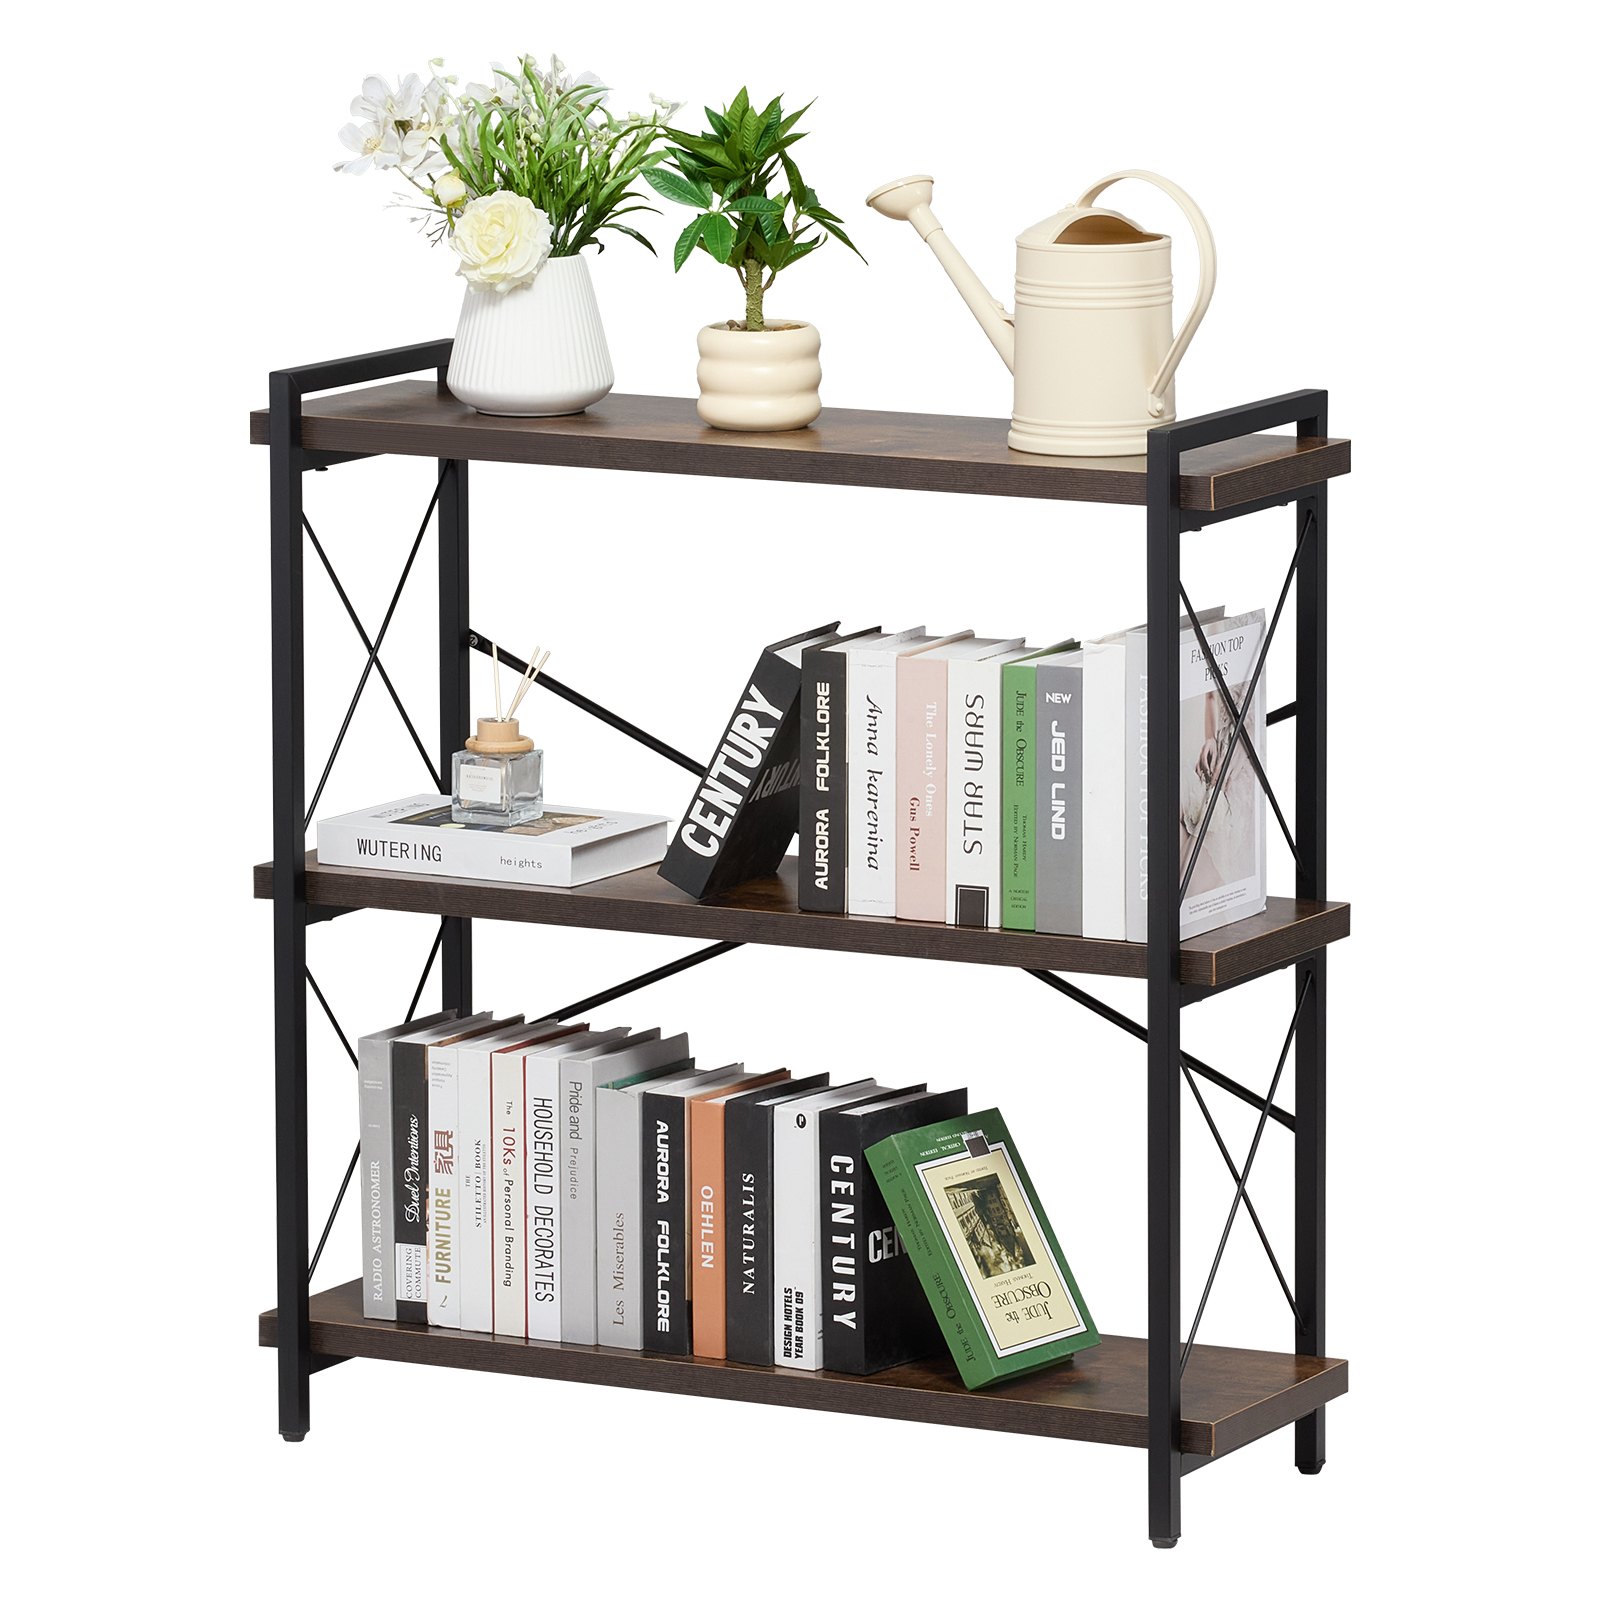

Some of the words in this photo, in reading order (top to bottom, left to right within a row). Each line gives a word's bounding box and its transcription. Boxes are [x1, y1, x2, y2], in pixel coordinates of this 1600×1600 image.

[1228, 635, 1244, 652] TOP
[925, 702, 937, 728] The
[1015, 690, 1027, 717] JUDE
[1046, 692, 1072, 704] NEW
[816, 682, 830, 791] FOLKLORE
[866, 694, 883, 756] Anna
[964, 694, 984, 772] WARS
[1016, 719, 1024, 732] the
[1051, 720, 1065, 772] JED
[681, 684, 784, 858] CENTURY
[922, 731, 937, 780] Lonely
[1015, 738, 1028, 787] OBSCURE
[909, 797, 920, 822] Gus
[925, 783, 937, 817] Ones
[963, 781, 983, 855] STAR
[1051, 783, 1065, 840] LIND
[356, 838, 442, 863] WUTERING
[500, 856, 543, 870] heights
[814, 809, 829, 890] AURORA
[909, 827, 920, 871] Powell
[569, 1081, 583, 1114] Pride
[502, 1127, 516, 1165] 10Ks
[533, 1097, 554, 1195] HOUSEHOLD
[569, 1115, 583, 1140] and
[503, 1168, 510, 1177] of
[568, 1147, 579, 1200] Prejudice
[656, 1119, 670, 1204] AURORA
[370, 1160, 382, 1253] ASTRONOMER
[403, 1183, 420, 1223] Duel
[504, 1179, 514, 1231] Personal
[435, 1188, 452, 1284] FURNITURE
[700, 1185, 714, 1269] OEHLEN
[742, 1172, 755, 1295] NATURALIS
[830, 1154, 857, 1330] CENTURY
[502, 1236, 515, 1287] Branding
[534, 1205, 555, 1302] DECORATES
[612, 1212, 625, 1291] Miserables
[373, 1258, 383, 1302] RADIO
[656, 1220, 670, 1333] FOLKLORE
[932, 1272, 957, 1320] OBSCURE
[991, 1281, 1052, 1309] OBSCURE
[612, 1300, 625, 1326] Les
[783, 1287, 793, 1322] HOTELS
[795, 1307, 804, 1333] BOOK
[1005, 1311, 1020, 1324] the
[1021, 1301, 1053, 1320] JUDE
[783, 1324, 793, 1358] DESIGN
[794, 1335, 804, 1359] YEAR
[955, 1322, 964, 1335] the
[960, 1336, 976, 1363] JUDE
